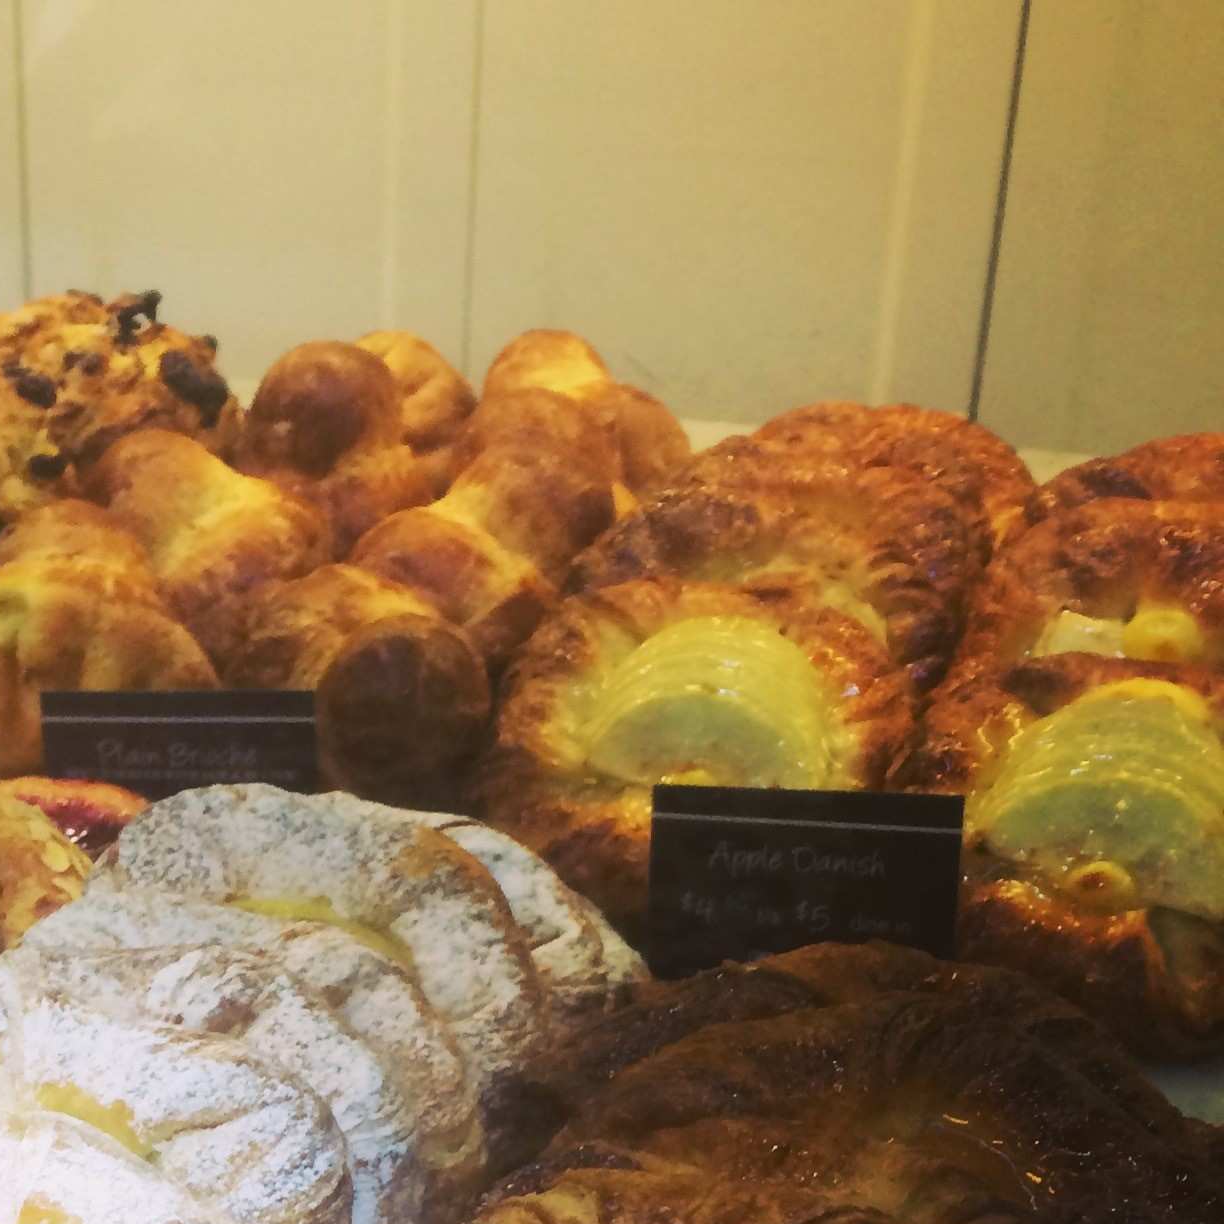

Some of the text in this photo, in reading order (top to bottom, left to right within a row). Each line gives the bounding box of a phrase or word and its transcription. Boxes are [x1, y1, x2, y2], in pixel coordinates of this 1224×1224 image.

[707, 839, 886, 880] Apple Danish
[795, 898, 831, 932] $5
